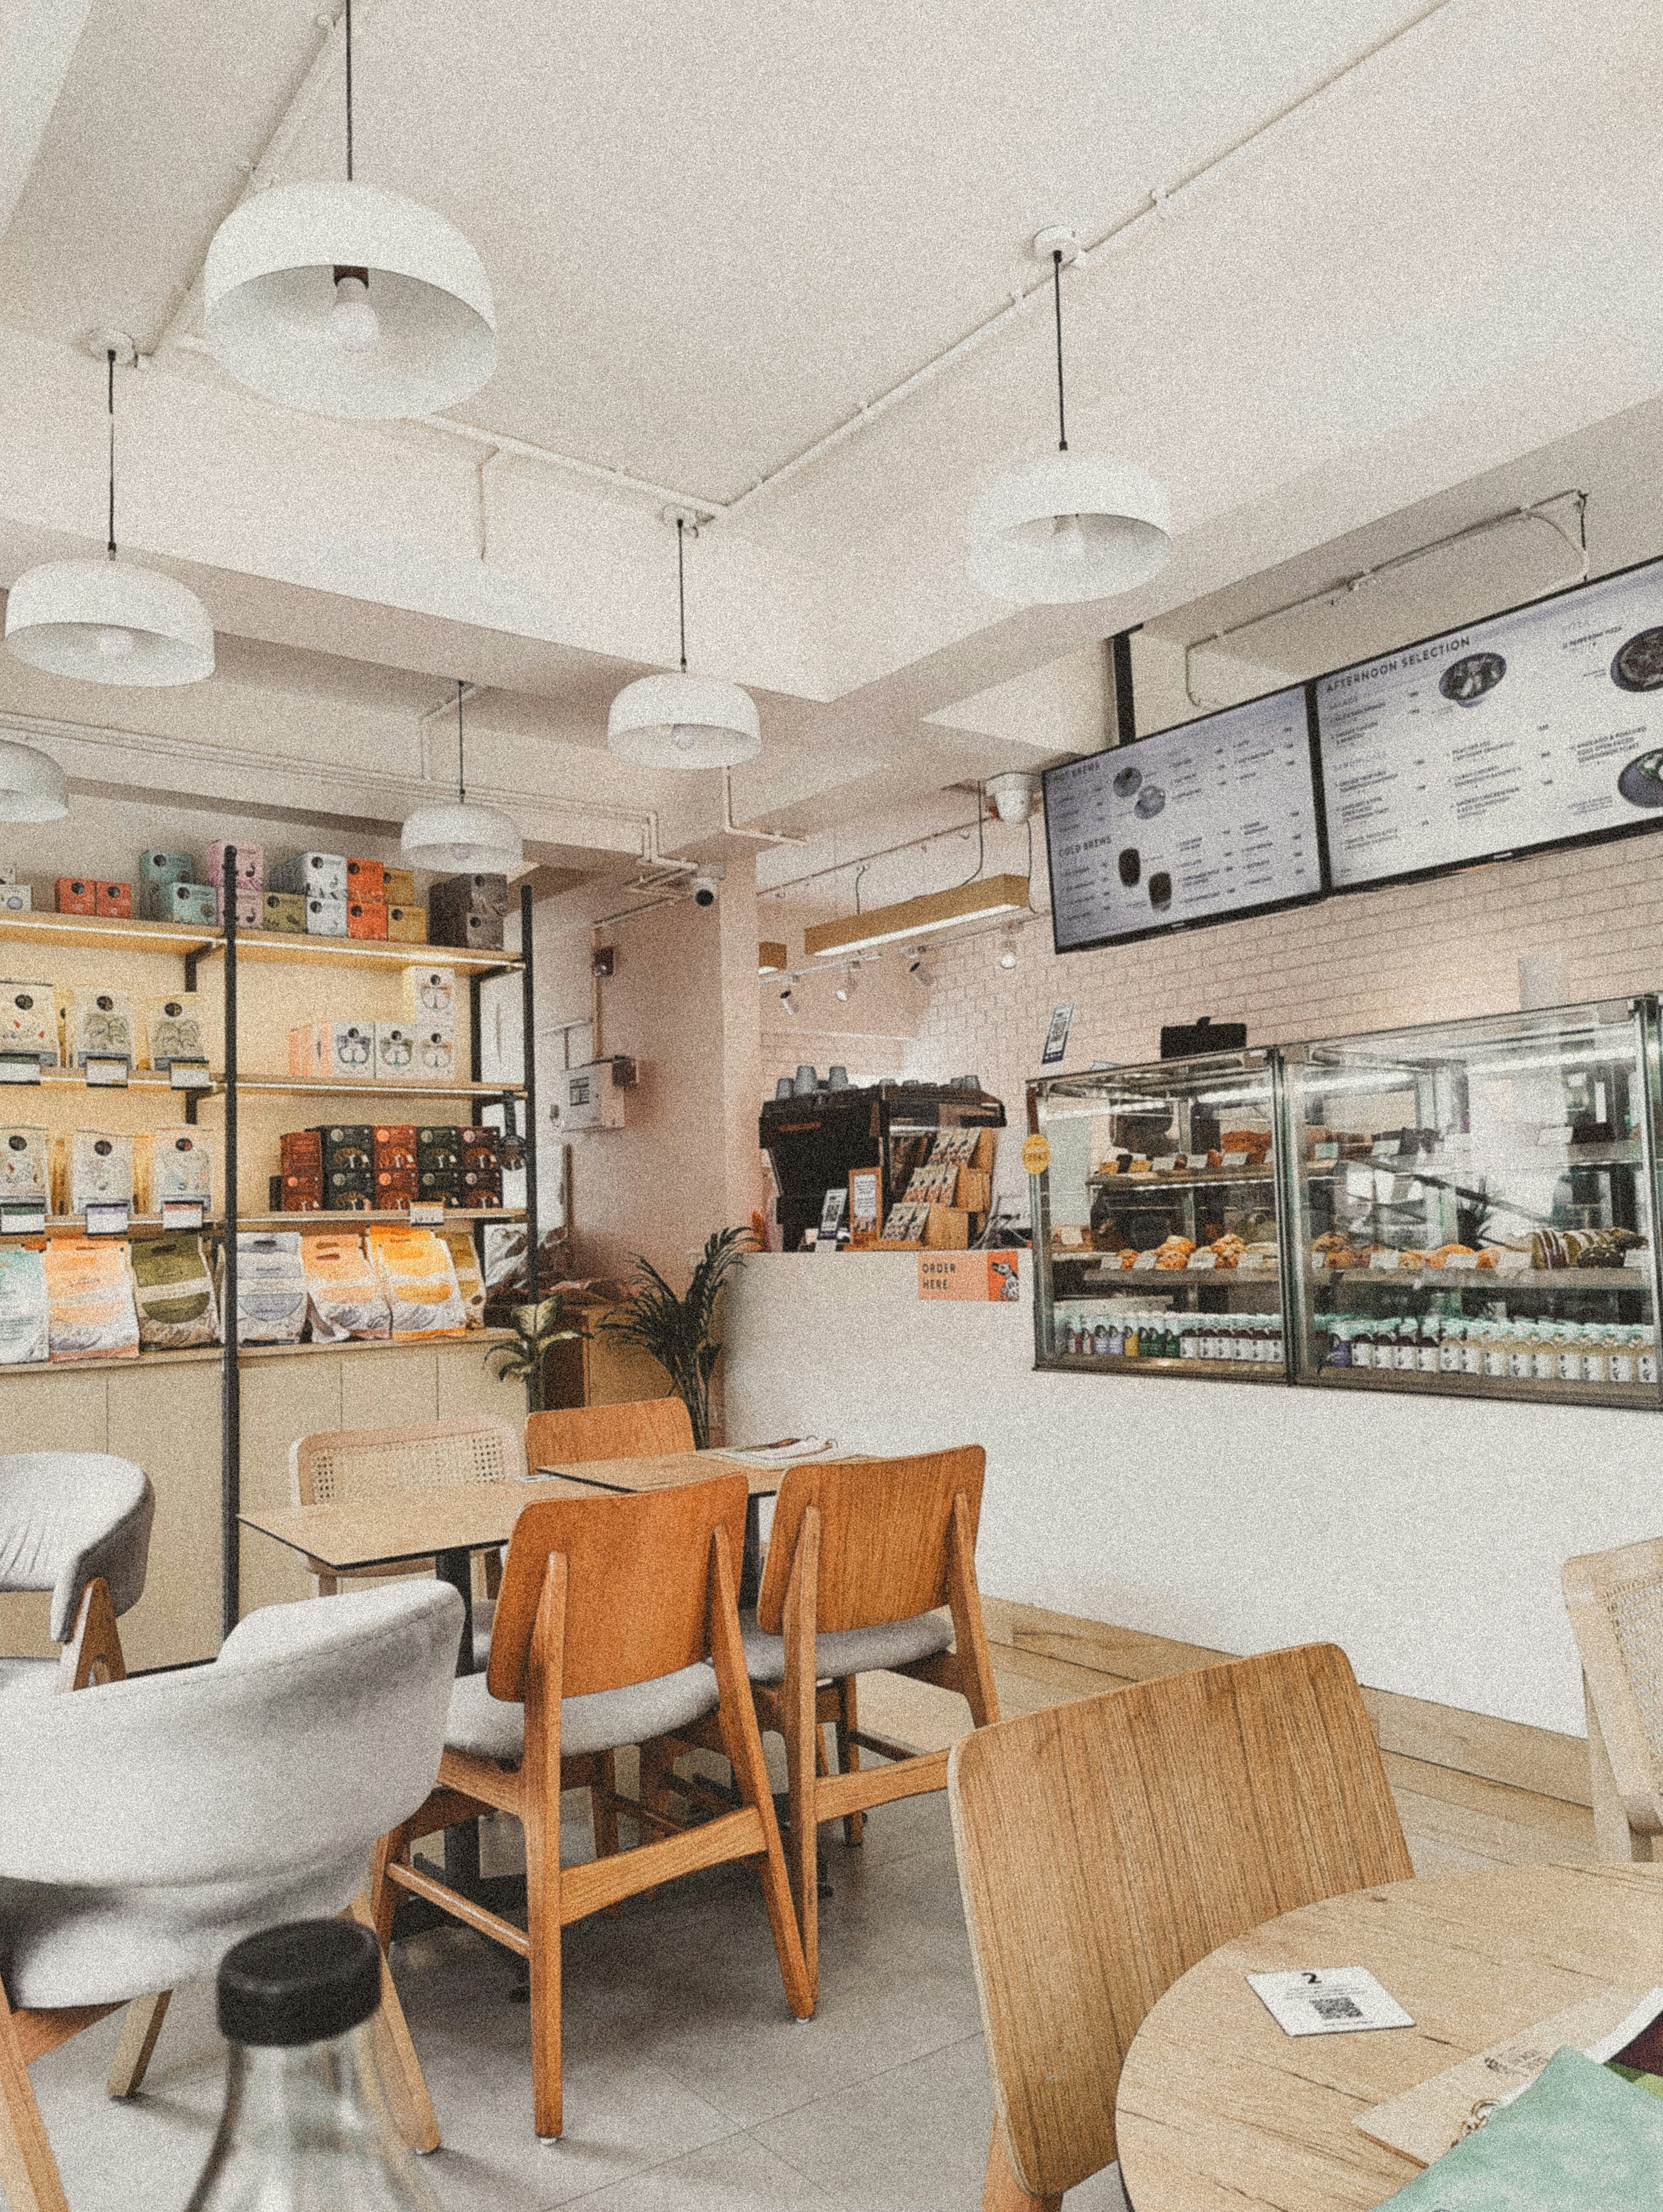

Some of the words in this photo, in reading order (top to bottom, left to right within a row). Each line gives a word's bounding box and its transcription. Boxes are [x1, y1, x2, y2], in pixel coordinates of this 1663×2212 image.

[1326, 660, 1397, 692] AFTERNOON
[1402, 636, 1470, 668] SELECTION
[922, 1263, 956, 1274] ORDER
[923, 1279, 948, 1290] HERE
[1302, 1972, 1322, 1985] 2
